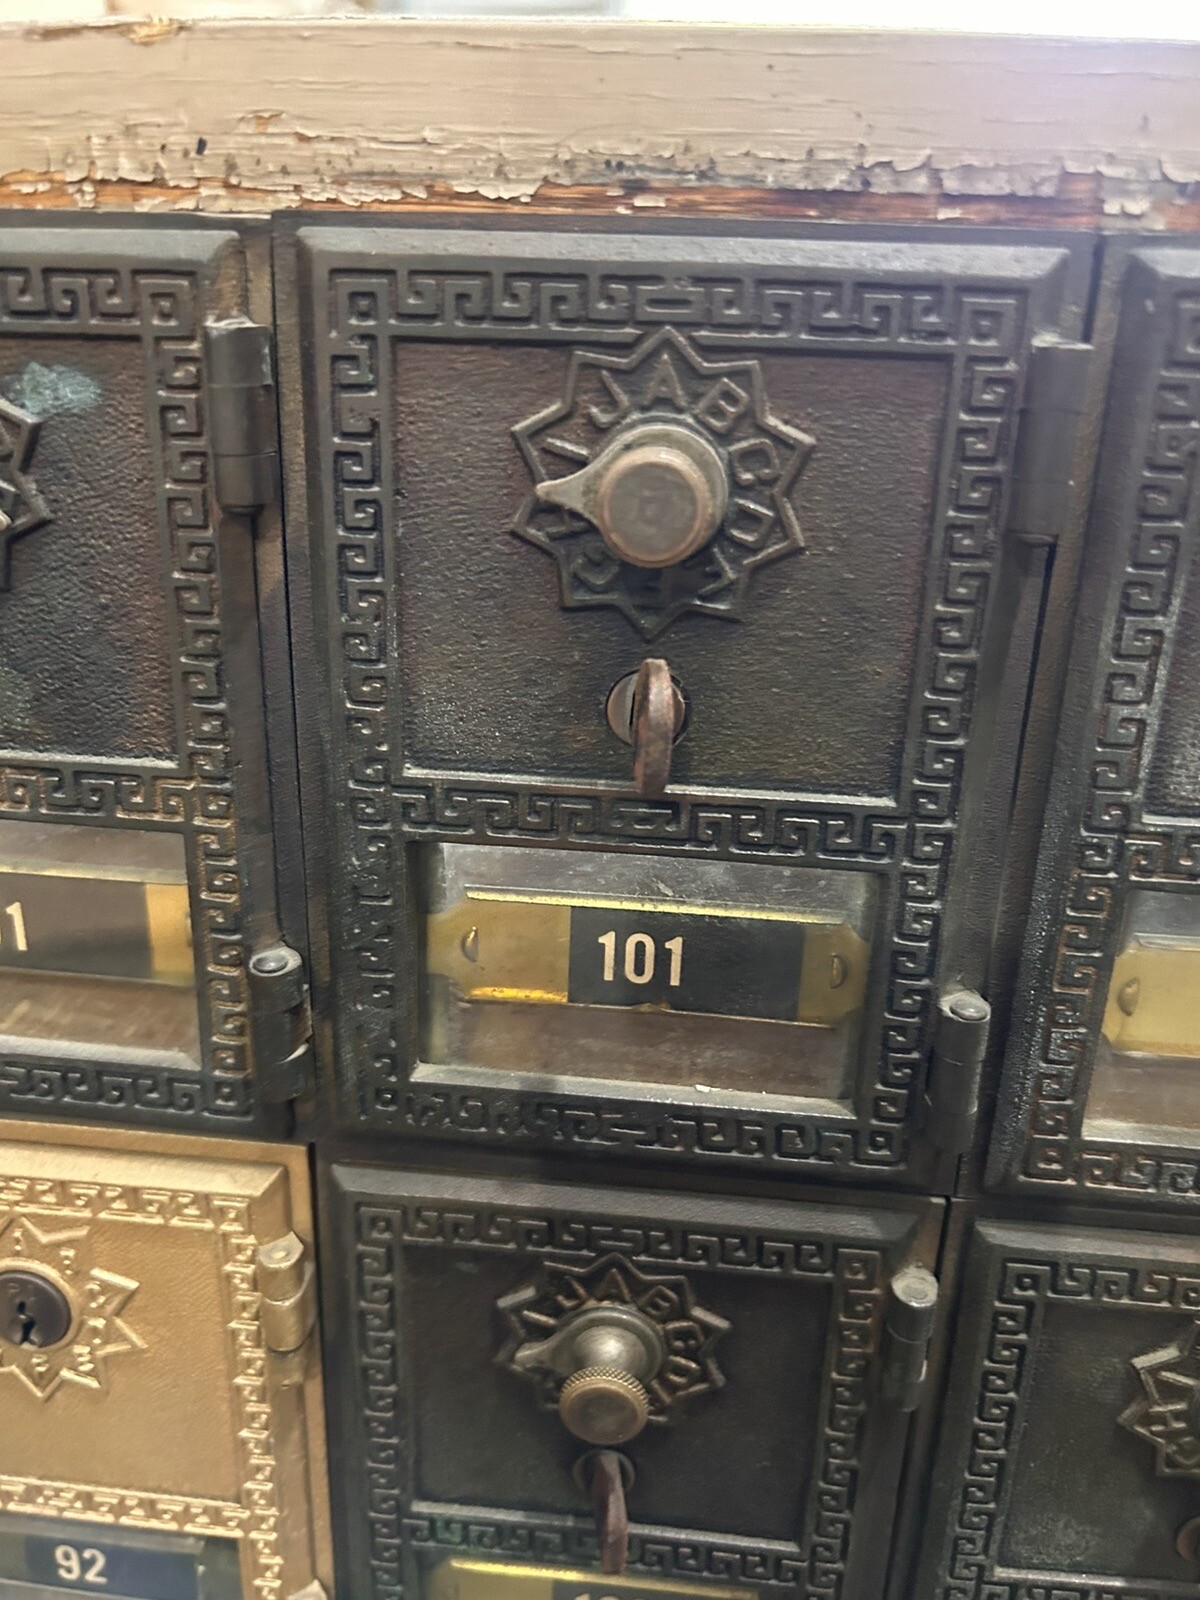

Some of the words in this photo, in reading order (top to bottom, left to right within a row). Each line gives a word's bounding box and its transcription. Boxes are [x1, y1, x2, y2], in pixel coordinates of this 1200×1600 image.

[588, 369, 630, 428] J
[644, 353, 687, 408] A
[697, 376, 750, 434] B
[0, 901, 29, 951] 1
[598, 930, 684, 987] 101
[54, 1544, 109, 1585] 92
